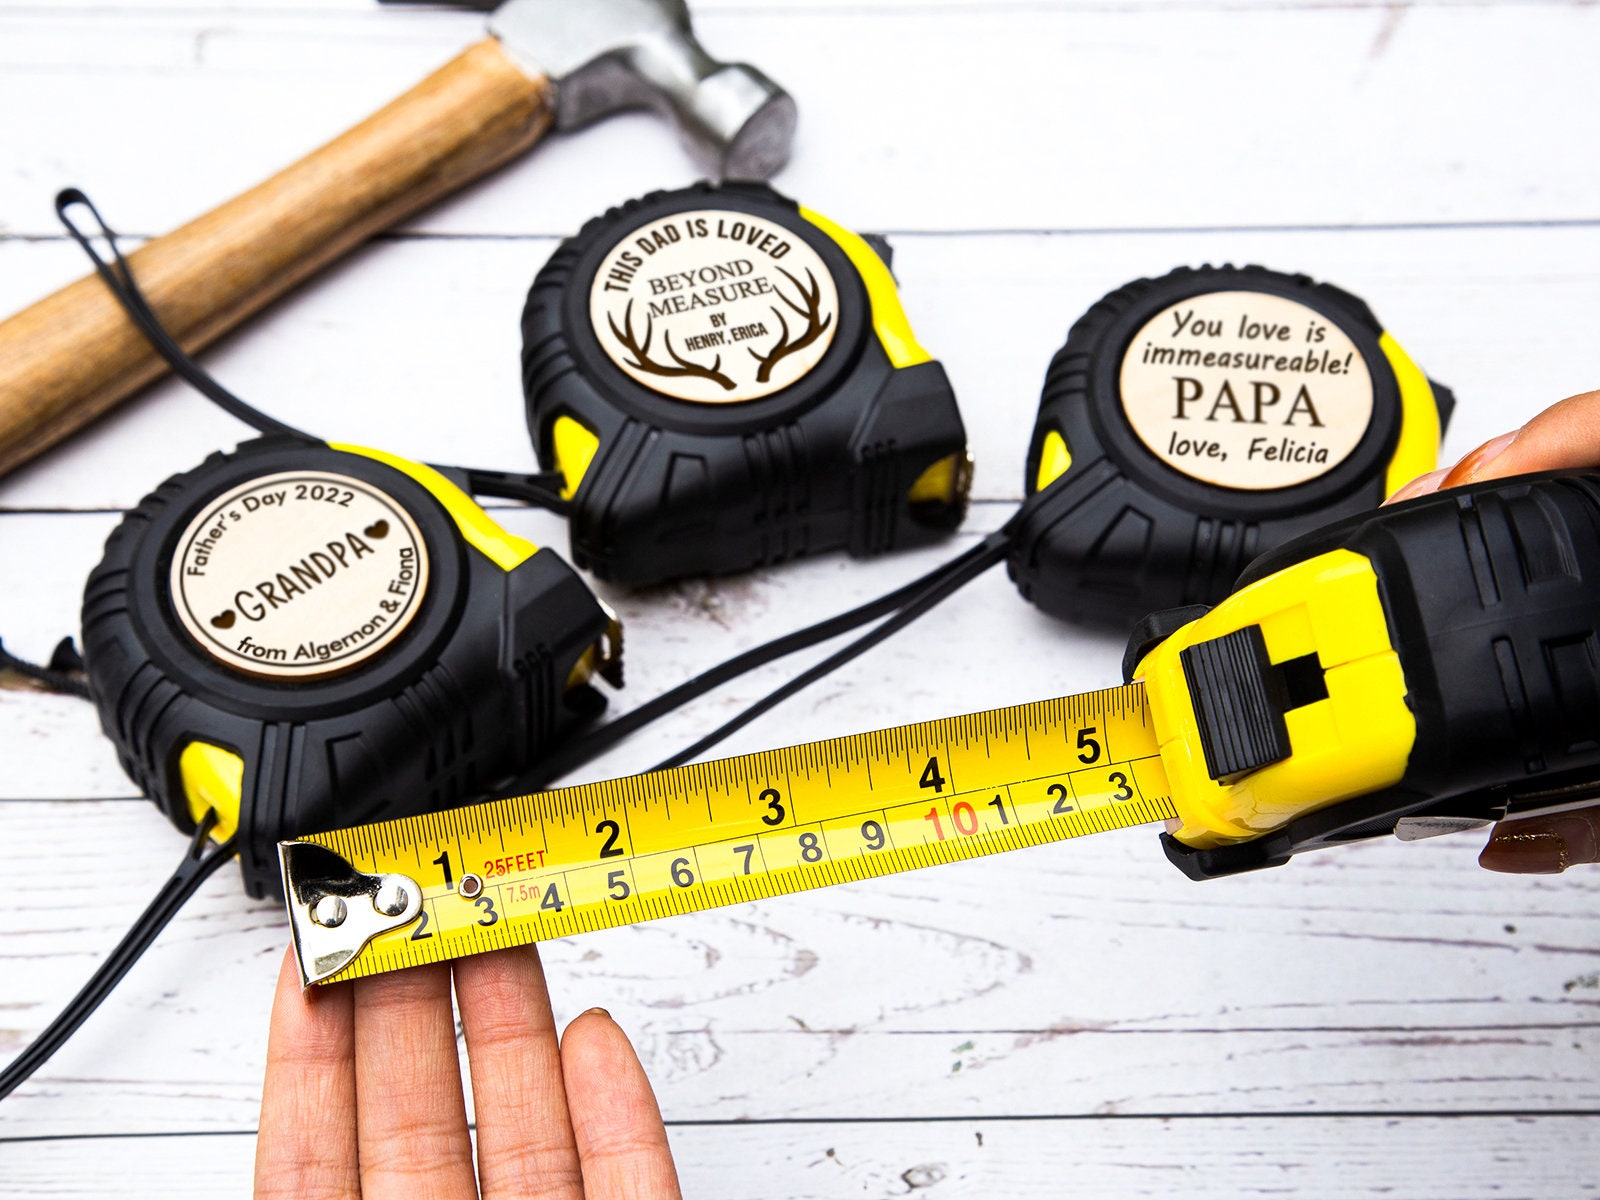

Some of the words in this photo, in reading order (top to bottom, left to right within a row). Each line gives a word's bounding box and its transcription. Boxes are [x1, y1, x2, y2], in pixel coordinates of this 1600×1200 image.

[604, 251, 643, 292] THIS
[636, 224, 681, 255] DAD
[686, 218, 708, 238] IS
[717, 219, 791, 260] LOVED
[647, 259, 753, 295] BEYOND
[648, 277, 773, 318] MEASURE
[685, 331, 731, 351] HENRY,
[731, 322, 768, 345] ERICA
[710, 312, 727, 328] BY
[1171, 310, 1222, 338] You
[1238, 314, 1290, 341] love
[1306, 321, 1326, 343] is
[1142, 342, 1352, 375] immeasureable!
[1171, 376, 1325, 427] PAPA
[1168, 431, 1227, 462] love,
[1248, 437, 1328, 463] Felicia
[187, 510, 241, 576] Father's
[242, 490, 286, 512] Day
[294, 484, 354, 507] 2022
[234, 532, 374, 621] GRANDPA
[388, 547, 413, 595] Fiona
[379, 599, 401, 613] &
[237, 637, 287, 660] from
[293, 614, 386, 660] Algernon
[433, 851, 453, 890] 1
[595, 820, 623, 858] 2
[758, 788, 785, 825] 3
[919, 756, 945, 793] 4
[1076, 727, 1101, 764] 5
[411, 910, 432, 940] 2
[474, 897, 498, 926] 3
[541, 883, 564, 912] 4
[607, 870, 630, 900] 5
[670, 857, 694, 887] 6
[732, 844, 754, 875] 7
[800, 832, 823, 862] 8
[860, 820, 885, 850] 9
[924, 801, 978, 840] 10
[988, 794, 1009, 825] 1
[1047, 783, 1073, 814] 2
[1107, 772, 1133, 802] 3
[507, 885, 540, 903] 7.5m
